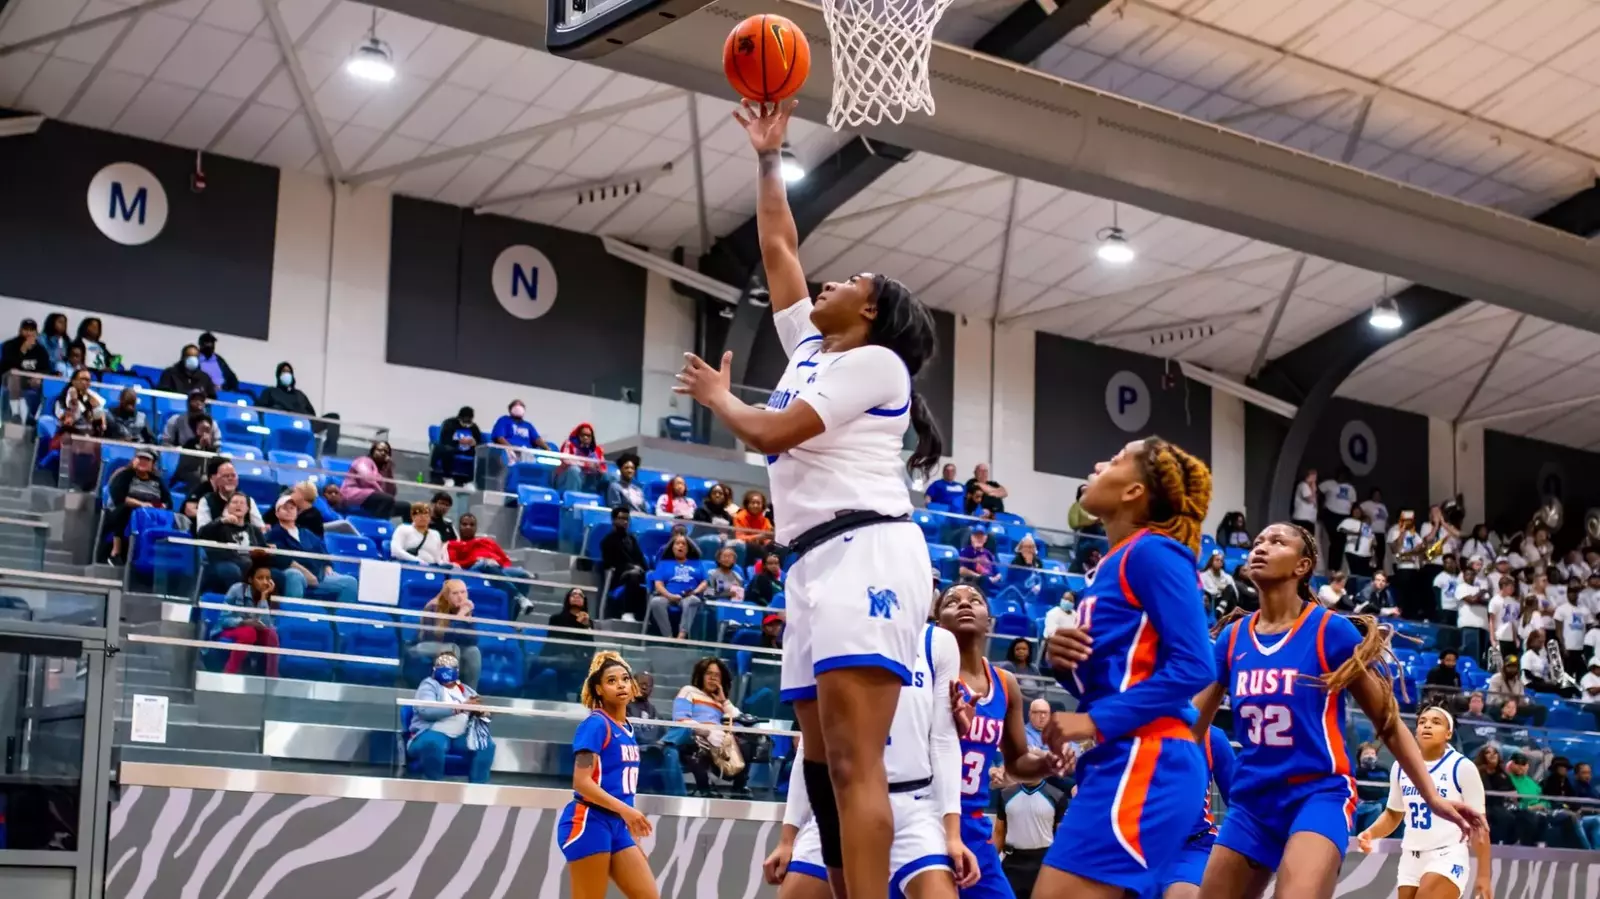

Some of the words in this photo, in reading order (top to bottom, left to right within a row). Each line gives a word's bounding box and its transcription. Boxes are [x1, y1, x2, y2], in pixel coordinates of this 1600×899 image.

[109, 181, 147, 225] M
[512, 262, 538, 301] N
[1119, 385, 1138, 415] P
[1349, 433, 1369, 465] Q
[1236, 668, 1299, 697] RUST
[963, 716, 1004, 745] UST
[1240, 704, 1293, 747] 32
[620, 744, 641, 762] RUS
[1409, 802, 1432, 830] 23
